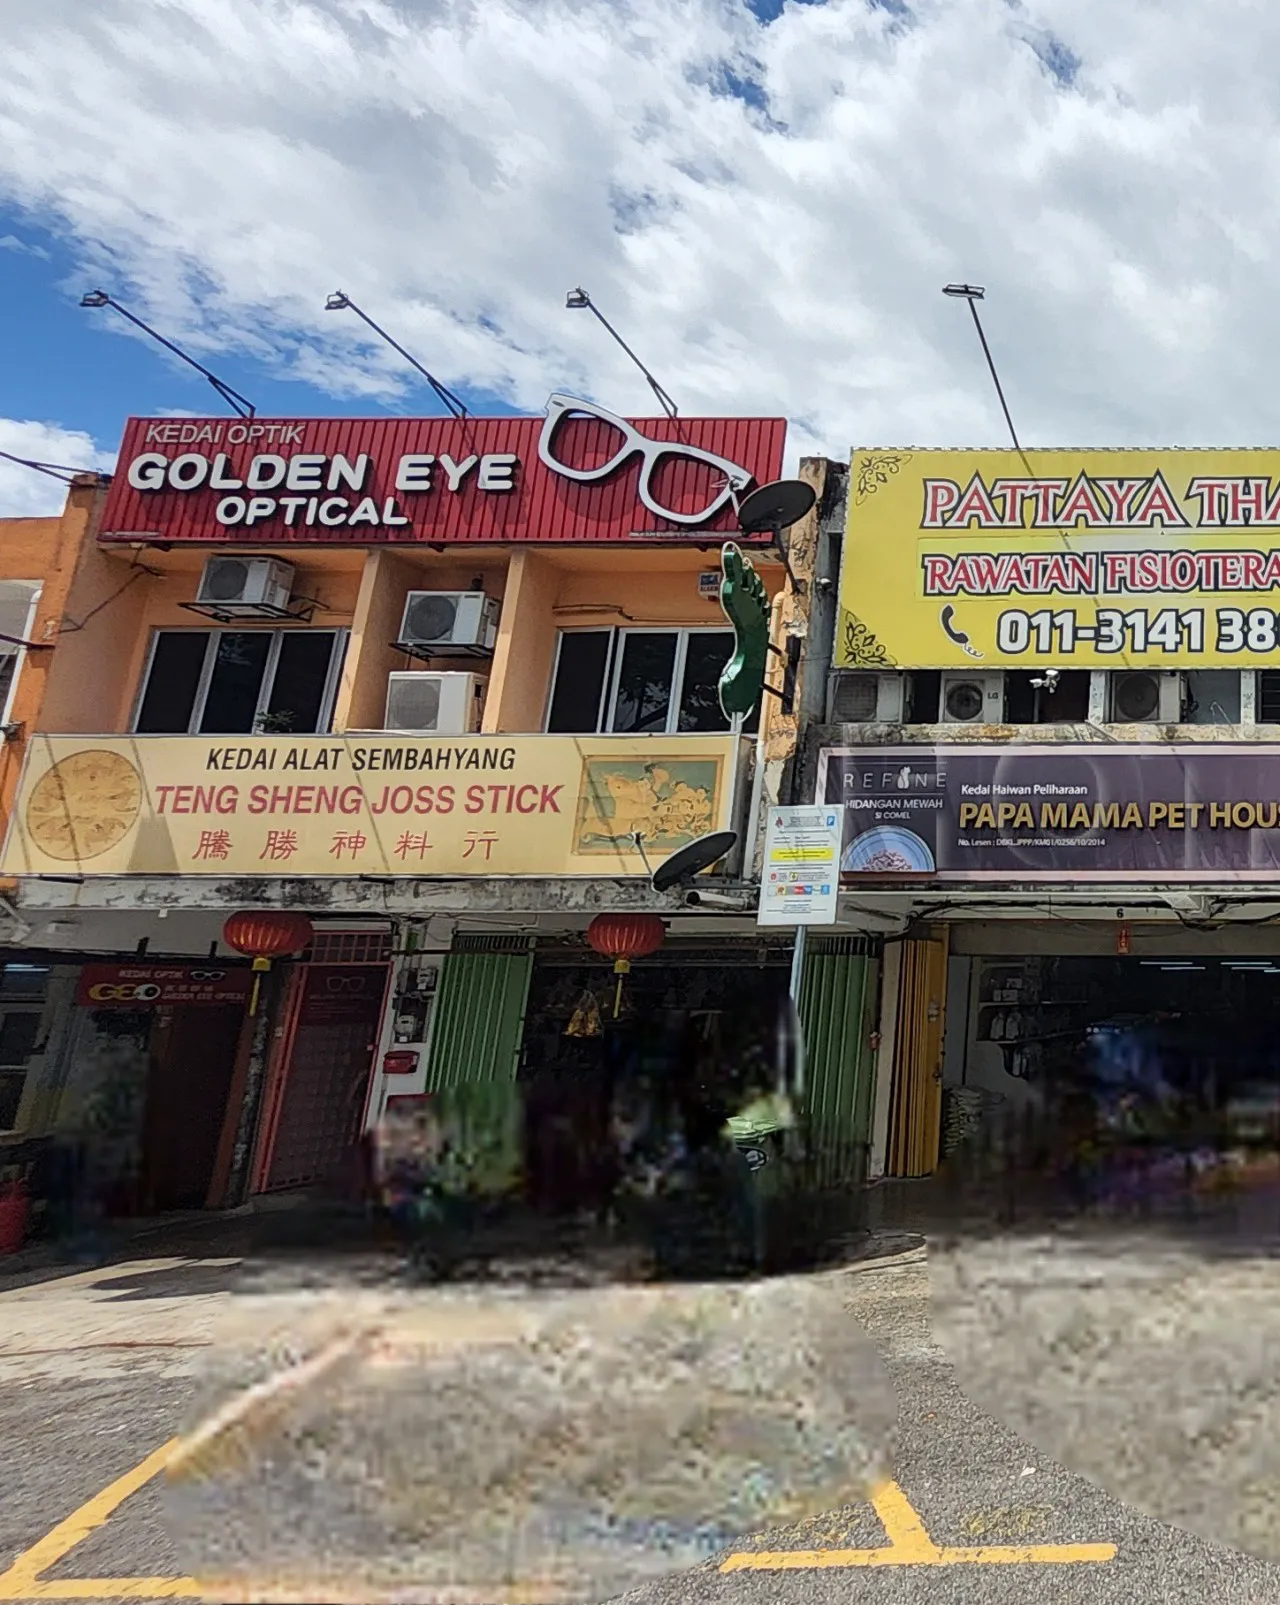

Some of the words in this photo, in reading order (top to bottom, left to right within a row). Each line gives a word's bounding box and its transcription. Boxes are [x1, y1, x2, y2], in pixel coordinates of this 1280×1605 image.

[145, 424, 223, 443] KEDAI
[227, 424, 305, 444] OPTIK
[128, 452, 368, 491] GOLDEN
[395, 453, 516, 491] EYE
[216, 496, 409, 525] OPTICAL
[919, 468, 1193, 529] PATTAYA
[922, 552, 1099, 596] RAWATAN
[996, 608, 1205, 653] 011-3141
[206, 748, 277, 770] KEDAI
[282, 748, 344, 770] ALAT
[351, 747, 516, 770] SEMBAHYANG
[155, 785, 239, 815] TENG
[247, 785, 363, 815] SHENG
[371, 785, 455, 815] JOSS
[464, 784, 565, 814] STICK
[961, 784, 990, 796] Kedai
[993, 784, 1031, 796] Haiwan
[1034, 784, 1088, 796] Peliharaan
[845, 799, 900, 809] HIDANGAN
[903, 799, 943, 809] MEWAH
[883, 811, 911, 819] COMEL
[959, 802, 1035, 829] PAPA
[1040, 802, 1143, 829] MAMA
[1149, 802, 1204, 828] PET
[1116, 908, 1124, 918] 6
